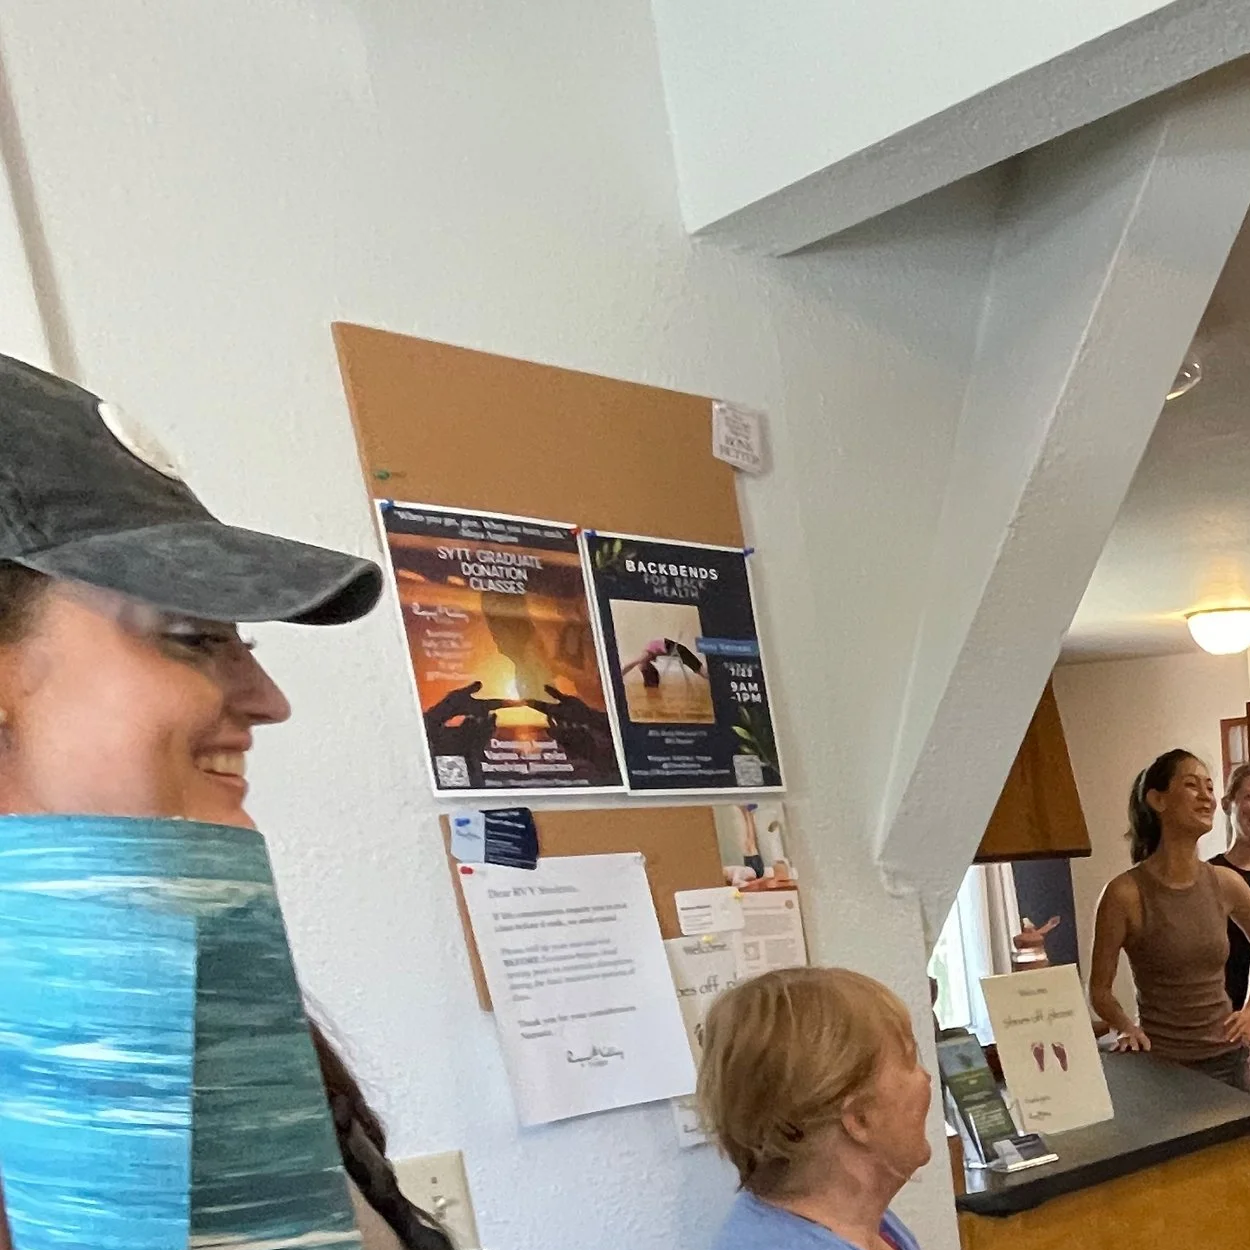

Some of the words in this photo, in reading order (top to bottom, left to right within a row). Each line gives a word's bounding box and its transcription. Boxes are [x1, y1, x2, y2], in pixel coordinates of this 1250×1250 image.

[476, 549, 544, 570] GRADUATE
[461, 561, 528, 582] DONATION
[625, 559, 718, 580] BACKBENDS
[469, 576, 526, 595] CLASSES
[643, 572, 667, 586] FOR
[674, 576, 706, 591] BACK
[653, 585, 699, 599] HEALTH
[730, 681, 759, 693] 9AM
